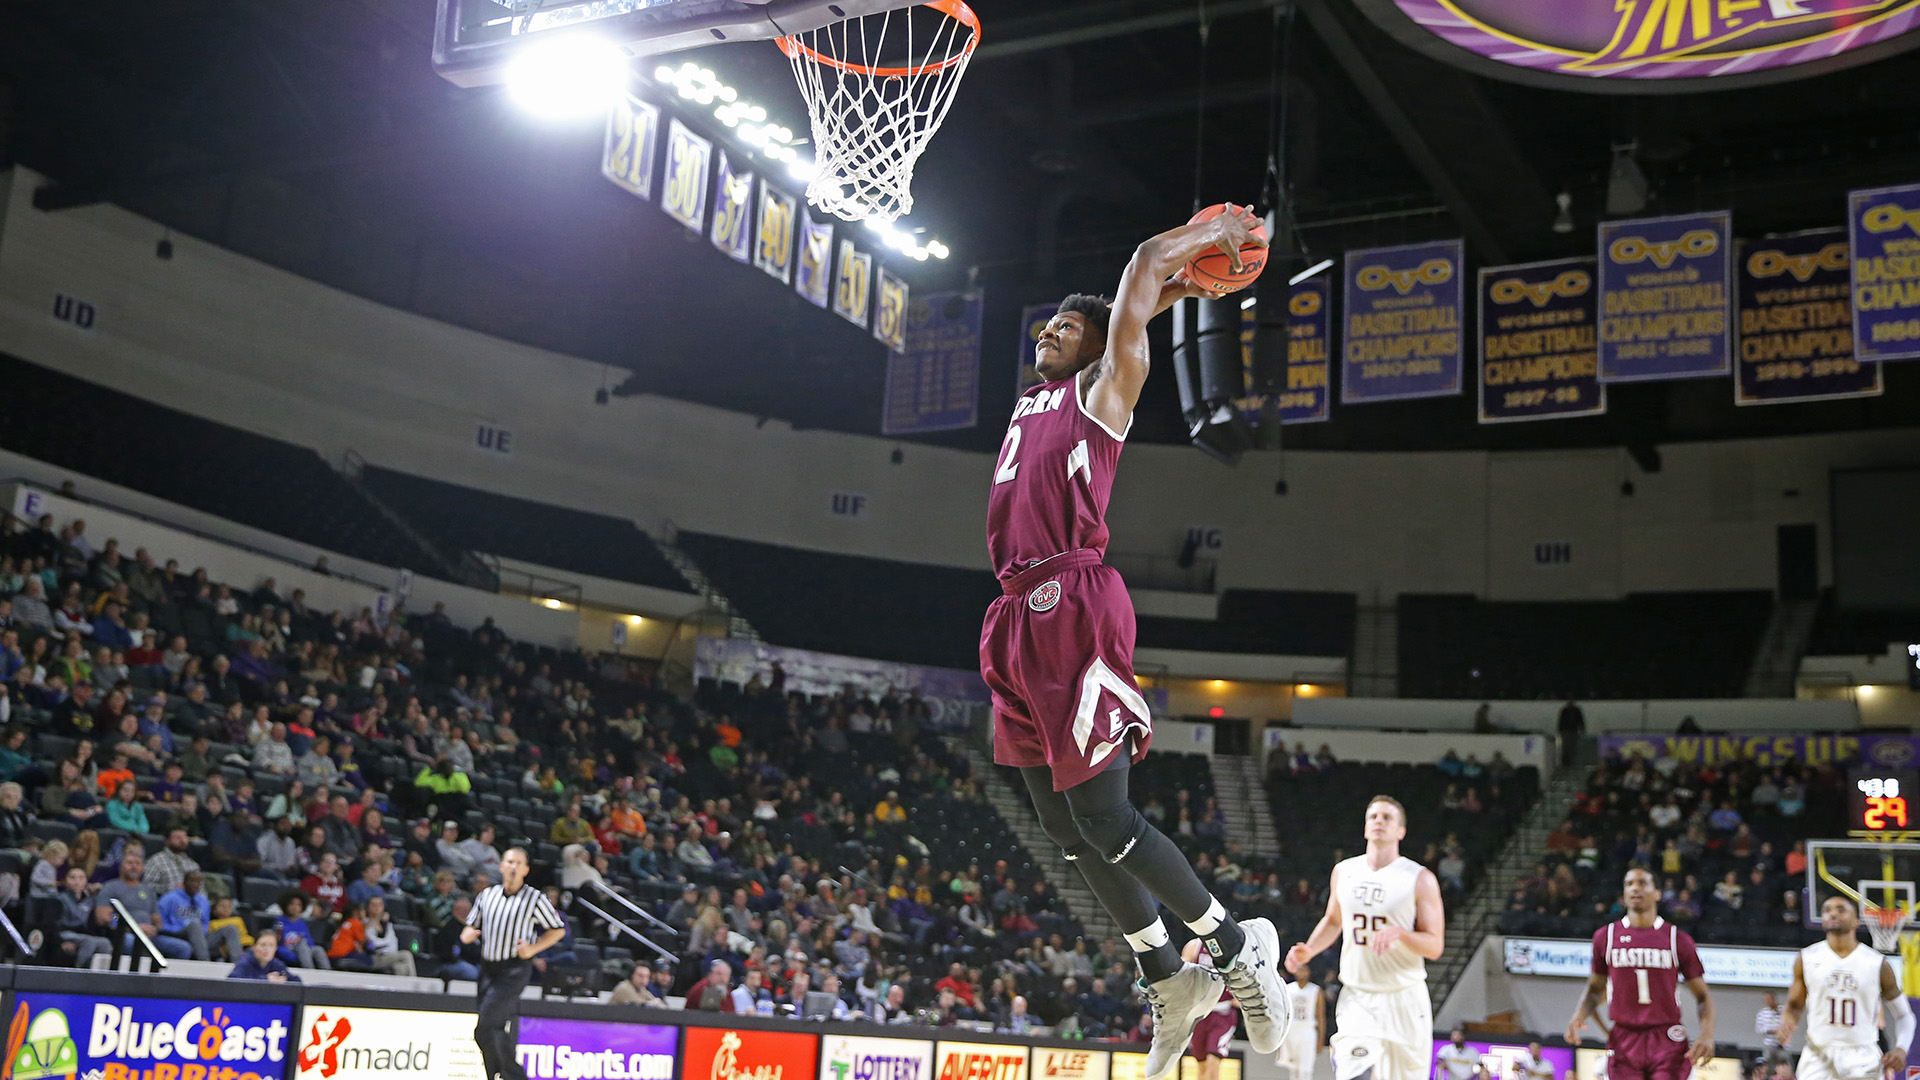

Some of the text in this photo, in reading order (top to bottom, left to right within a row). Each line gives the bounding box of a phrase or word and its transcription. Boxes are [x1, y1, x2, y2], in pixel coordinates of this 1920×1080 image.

[671, 134, 701, 217] 30
[1609, 230, 1719, 268] OVC
[840, 250, 866, 317] 50
[1356, 258, 1453, 294] OVC
[1490, 271, 1591, 307] OVC
[54, 293, 95, 329] UD
[1605, 282, 1724, 314] BASKETBALL
[1350, 306, 1457, 337] BASKETBALL
[1602, 310, 1724, 342] CHAMPIONS
[1347, 332, 1457, 363] CHAMPIONS
[1485, 325, 1597, 359] BASKETBALL
[1485, 352, 1597, 386] CHAMPIONS
[478, 425, 512, 453] UE
[995, 424, 1022, 485] 2
[833, 494, 867, 516] UF
[1535, 543, 1571, 565] UH
[1037, 589, 1054, 604] OVC
[1109, 707, 1122, 732] E
[1665, 736, 1796, 767] WINGS
[1864, 797, 1908, 829] 29
[1611, 947, 1674, 970] EASTERN
[1634, 968, 1652, 1005] 1
[1825, 996, 1856, 1027] 10
[88, 1003, 288, 1063] BlueCoast
[342, 1041, 431, 1071] madd
[854, 1053, 922, 1080] LOTTERY
[936, 1053, 1024, 1080] AVERITT
[1061, 1052, 1090, 1071] LEE
